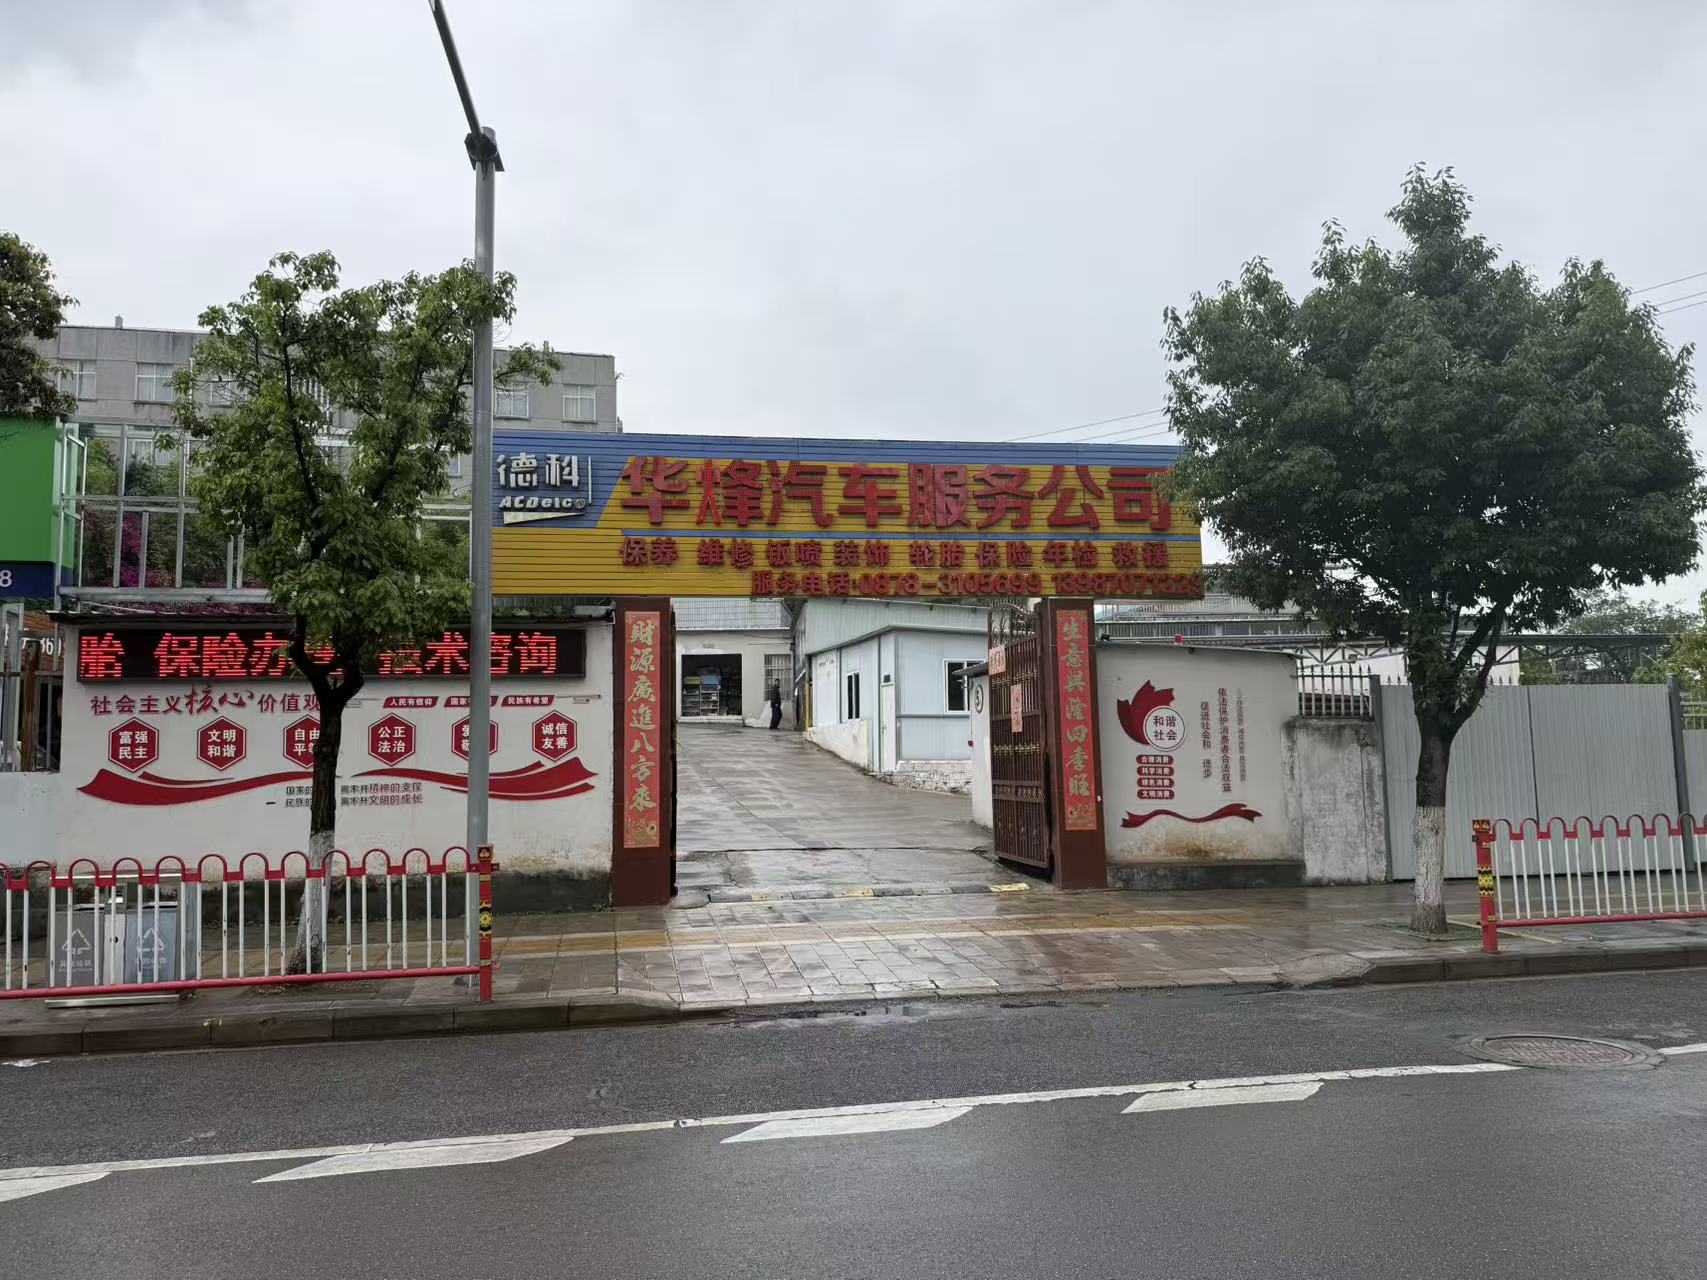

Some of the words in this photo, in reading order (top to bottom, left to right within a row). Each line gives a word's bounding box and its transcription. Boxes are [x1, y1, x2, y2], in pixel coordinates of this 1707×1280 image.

[496, 452, 579, 488] 德科
[621, 456, 1172, 531] 华烽汽车服务公司
[620, 537, 678, 568] 保养
[697, 538, 754, 568] 维修
[834, 539, 890, 568] 装饰
[909, 541, 965, 568] 轮胎
[976, 541, 1033, 568] 保险
[1043, 541, 1097, 569] 年检
[1111, 542, 1169, 569] 救援
[90, 685, 321, 716] 社会主义核心价值观
[390, 697, 433, 706] 人民有信仰
[508, 696, 549, 705] 民族有希望
[1153, 715, 1177, 728] 和谐
[294, 728, 320, 741] 自由
[378, 726, 406, 738] 公正
[541, 723, 568, 735] 诚信
[1153, 729, 1177, 741] 社会
[119, 731, 149, 745] 富强
[207, 729, 237, 743] 文明
[1217, 687, 1232, 793] 依法保护消费者合法权益
[378, 740, 406, 753] 法治
[541, 737, 568, 750] 友善
[119, 746, 149, 760] 民主
[207, 744, 237, 758] 和谐
[1141, 767, 1170, 775] 科学消费
[1142, 790, 1170, 798] 文明消费
